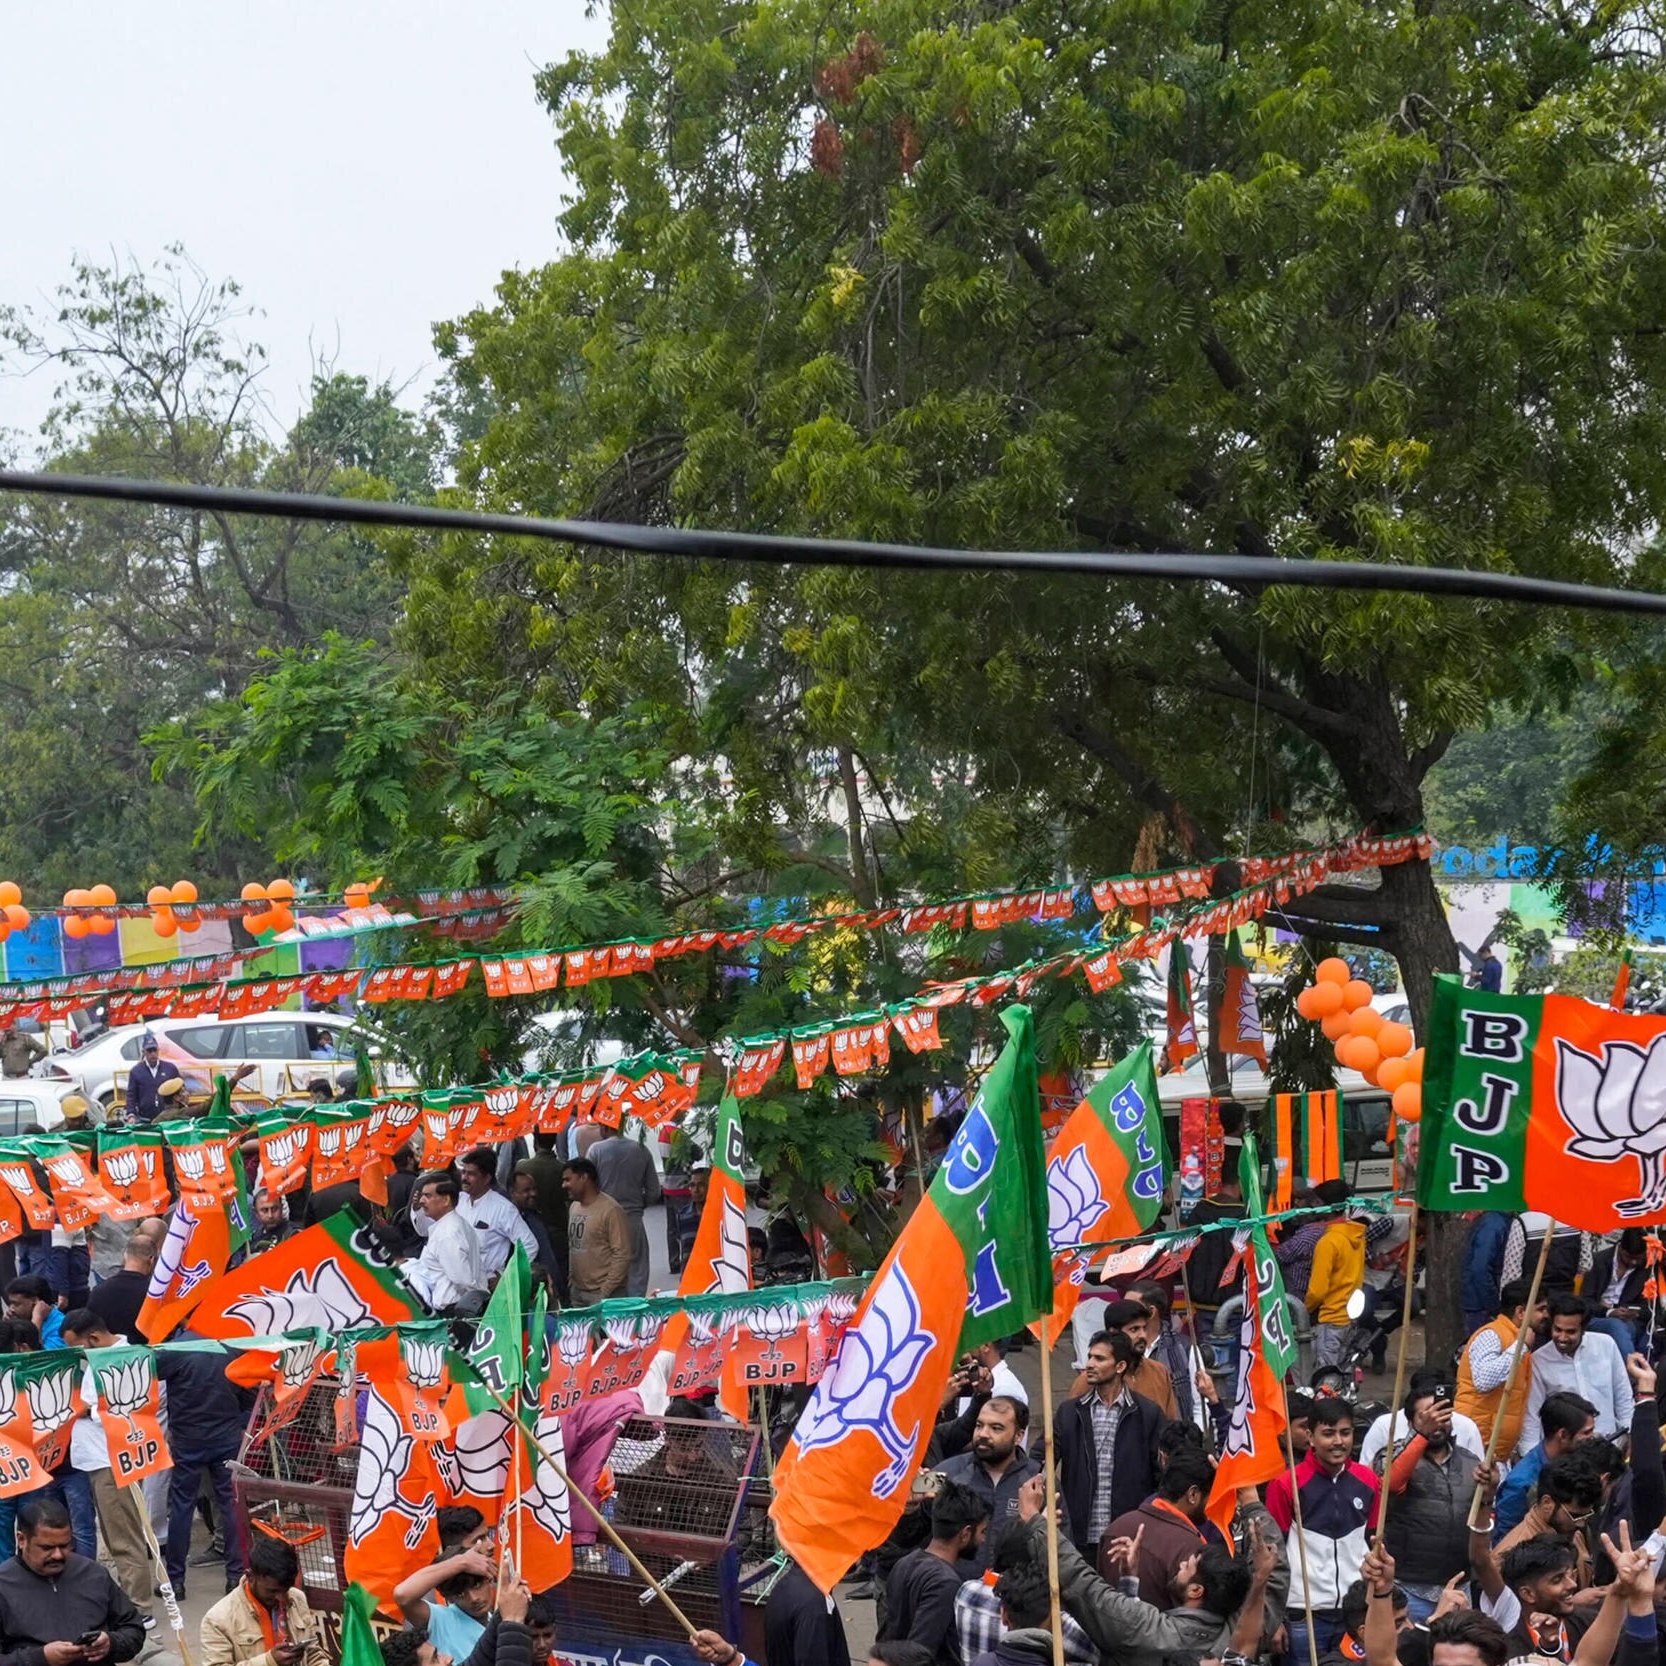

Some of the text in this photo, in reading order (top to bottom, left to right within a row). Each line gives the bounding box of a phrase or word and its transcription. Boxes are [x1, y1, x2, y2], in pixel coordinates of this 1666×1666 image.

[1448, 1007, 1528, 1194] BJP
[673, 1372, 700, 1390] BJP
[745, 1363, 797, 1380] BJP
[589, 1375, 618, 1396] BJP
[550, 1390, 581, 1412] BJP
[411, 1412, 439, 1434] BJP
[117, 1440, 158, 1476] BJP
